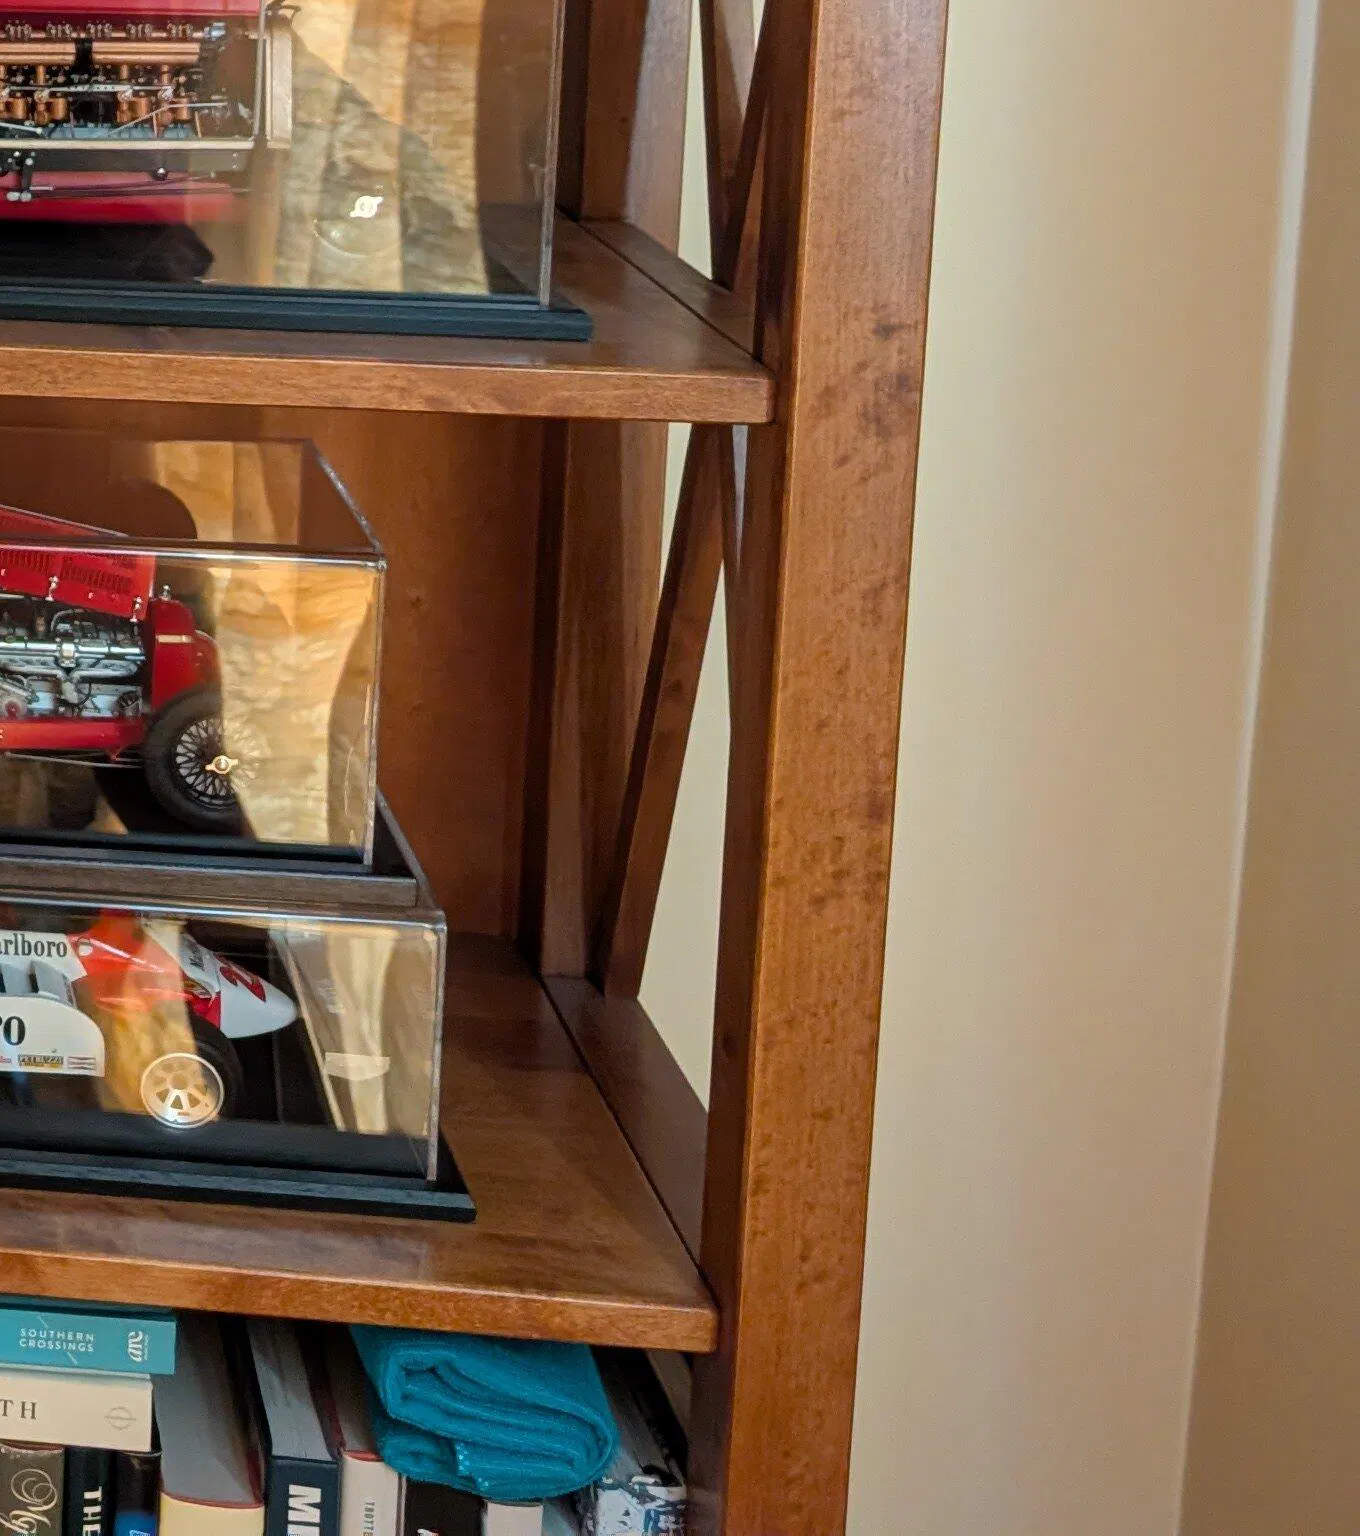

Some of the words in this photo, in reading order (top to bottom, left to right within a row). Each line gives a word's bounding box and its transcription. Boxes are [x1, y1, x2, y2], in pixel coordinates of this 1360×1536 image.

[19, 1328, 94, 1342] SOUTHERN
[19, 1338, 94, 1352] CROSSINGS
[83, 1486, 102, 1536] THE
